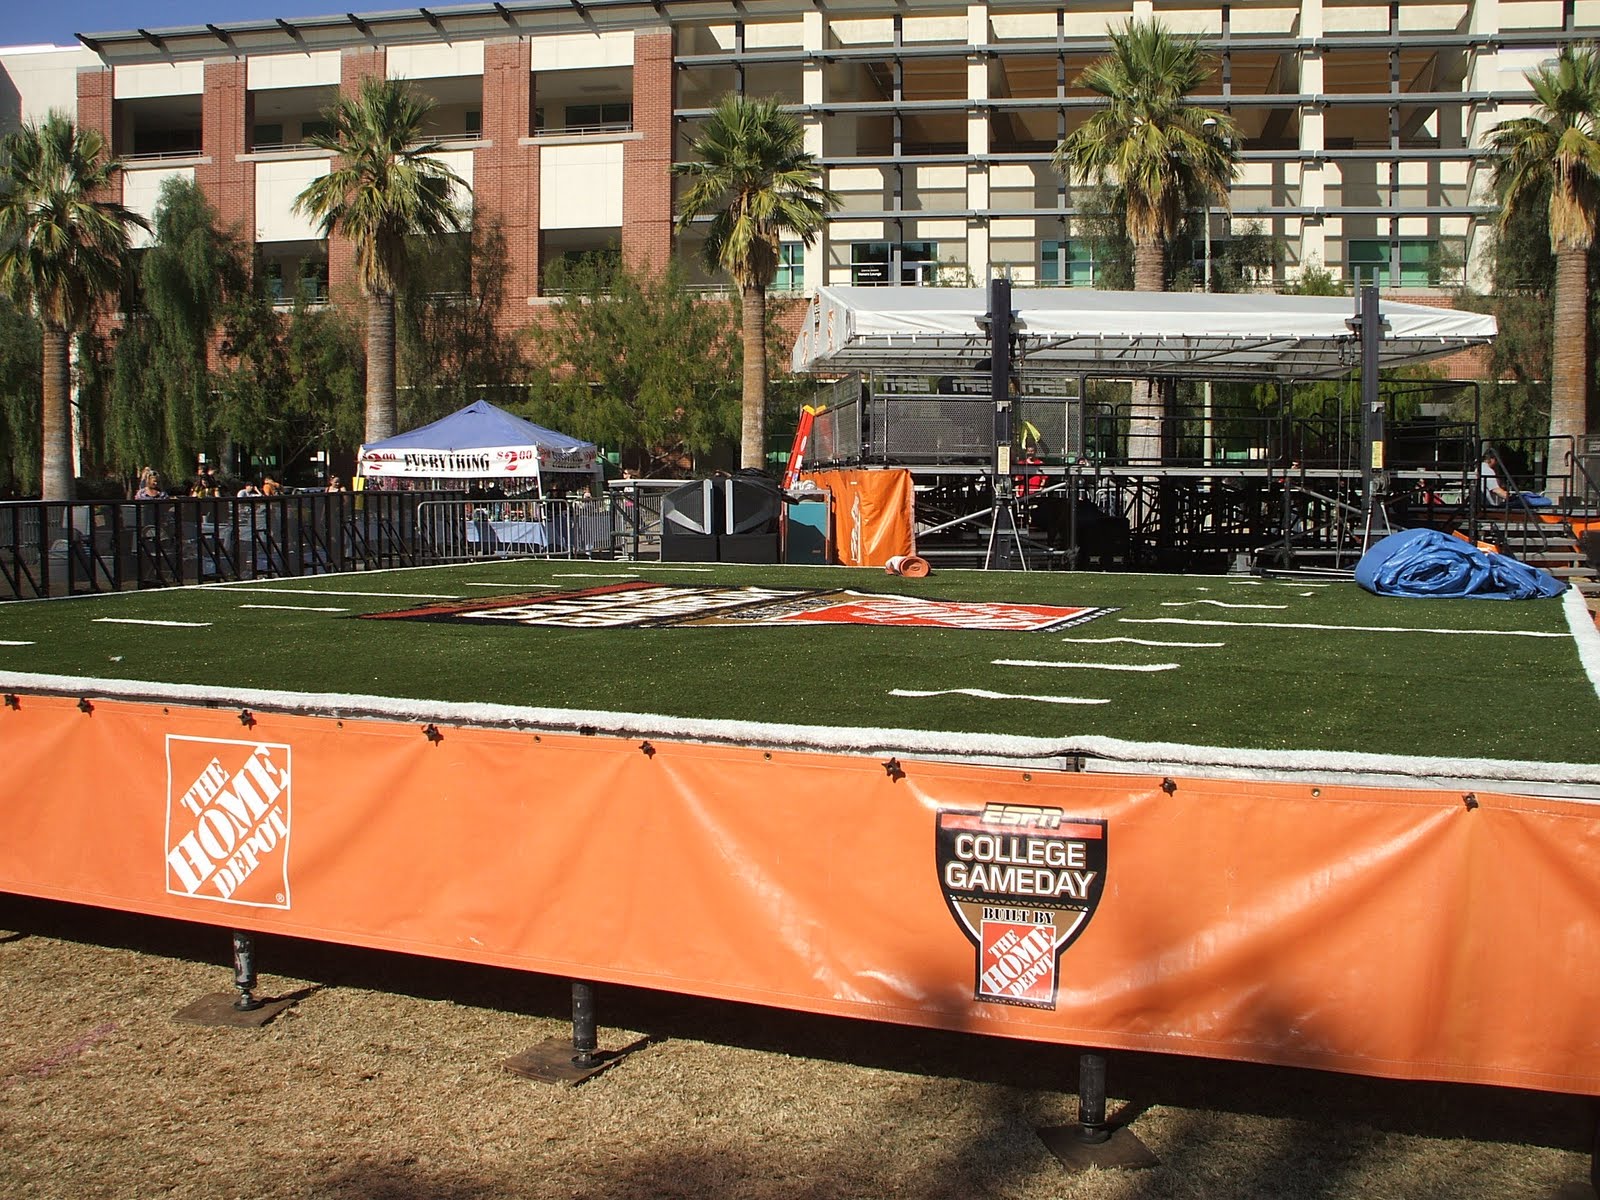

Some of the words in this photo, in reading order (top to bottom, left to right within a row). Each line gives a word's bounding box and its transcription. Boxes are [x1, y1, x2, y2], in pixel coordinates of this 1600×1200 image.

[404, 453, 490, 472] EVERYTHING
[180, 757, 230, 817] THE
[168, 745, 288, 894] HOME
[982, 804, 1063, 828] ESPN
[211, 805, 288, 899] DEPOT
[955, 834, 1085, 867] COLLEGE
[945, 862, 1096, 898] GAMEDAY
[983, 907, 1029, 922] BUILT
[1034, 911, 1055, 924] BY
[982, 926, 1055, 994] HOME
[988, 930, 1020, 959] THE
[1008, 953, 1054, 997] DEPOT
